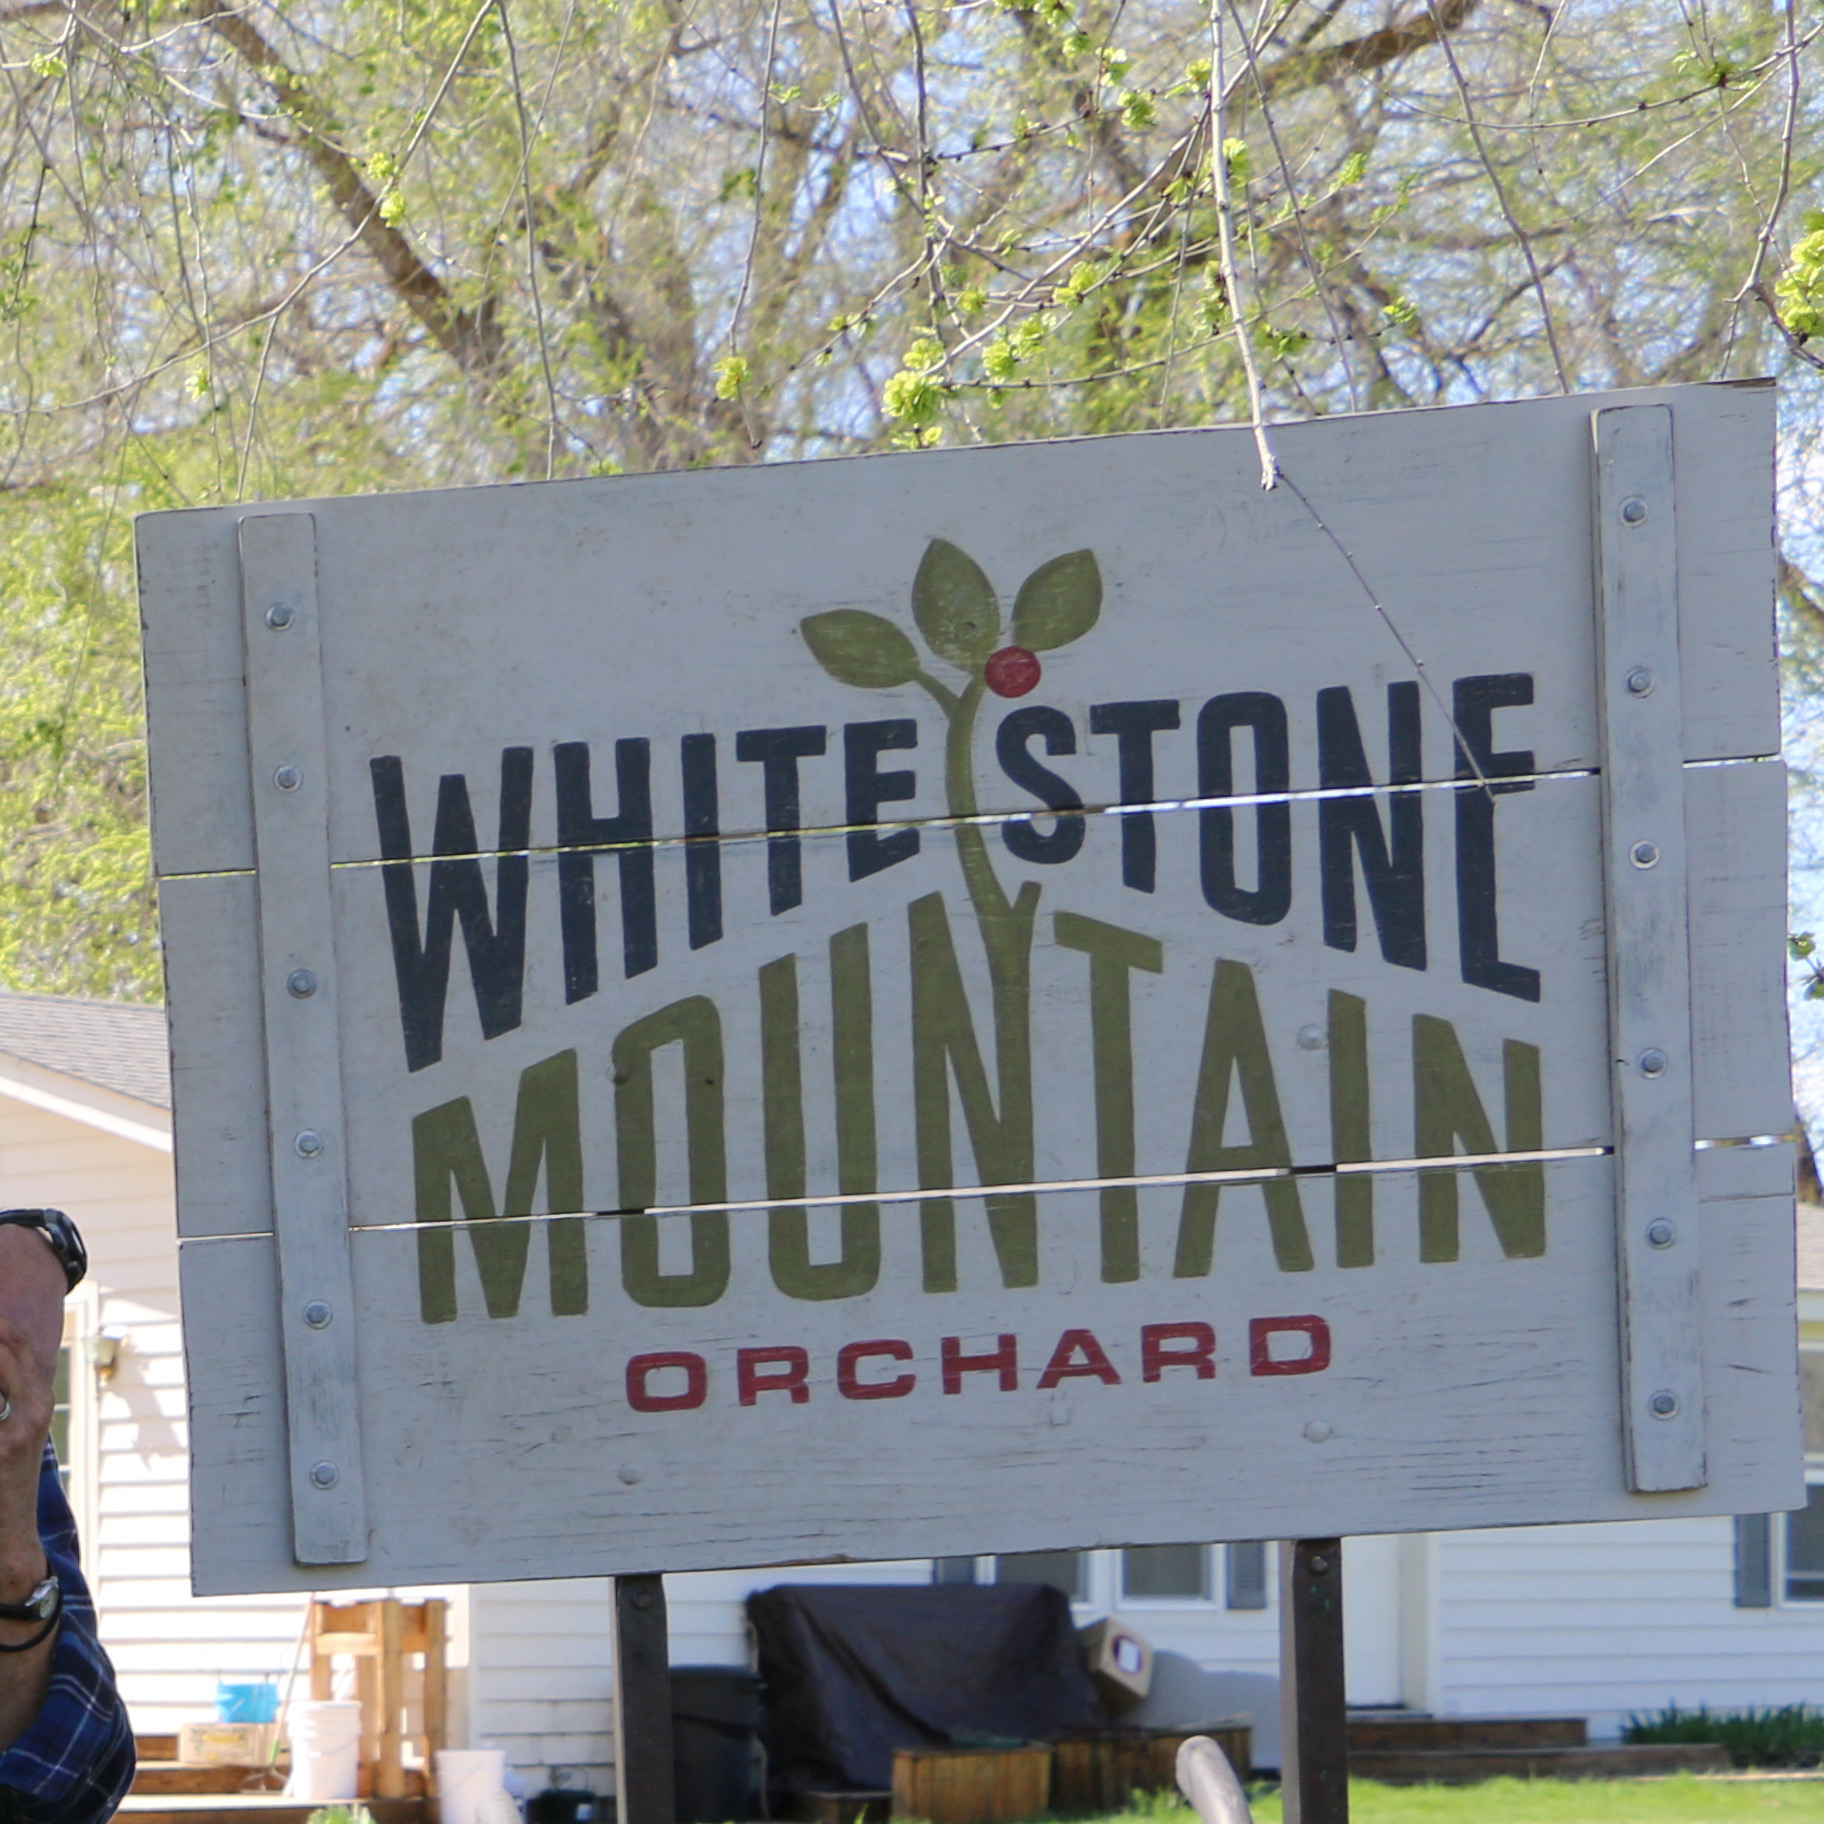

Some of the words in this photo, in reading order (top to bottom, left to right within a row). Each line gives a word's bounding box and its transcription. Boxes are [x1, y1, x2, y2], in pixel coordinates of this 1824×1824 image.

[370, 719, 920, 1073] WHITE
[995, 673, 1541, 1002] STONE
[411, 882, 1547, 1324] MOUNTAIN
[625, 1315, 1332, 1413] ORCHARD
